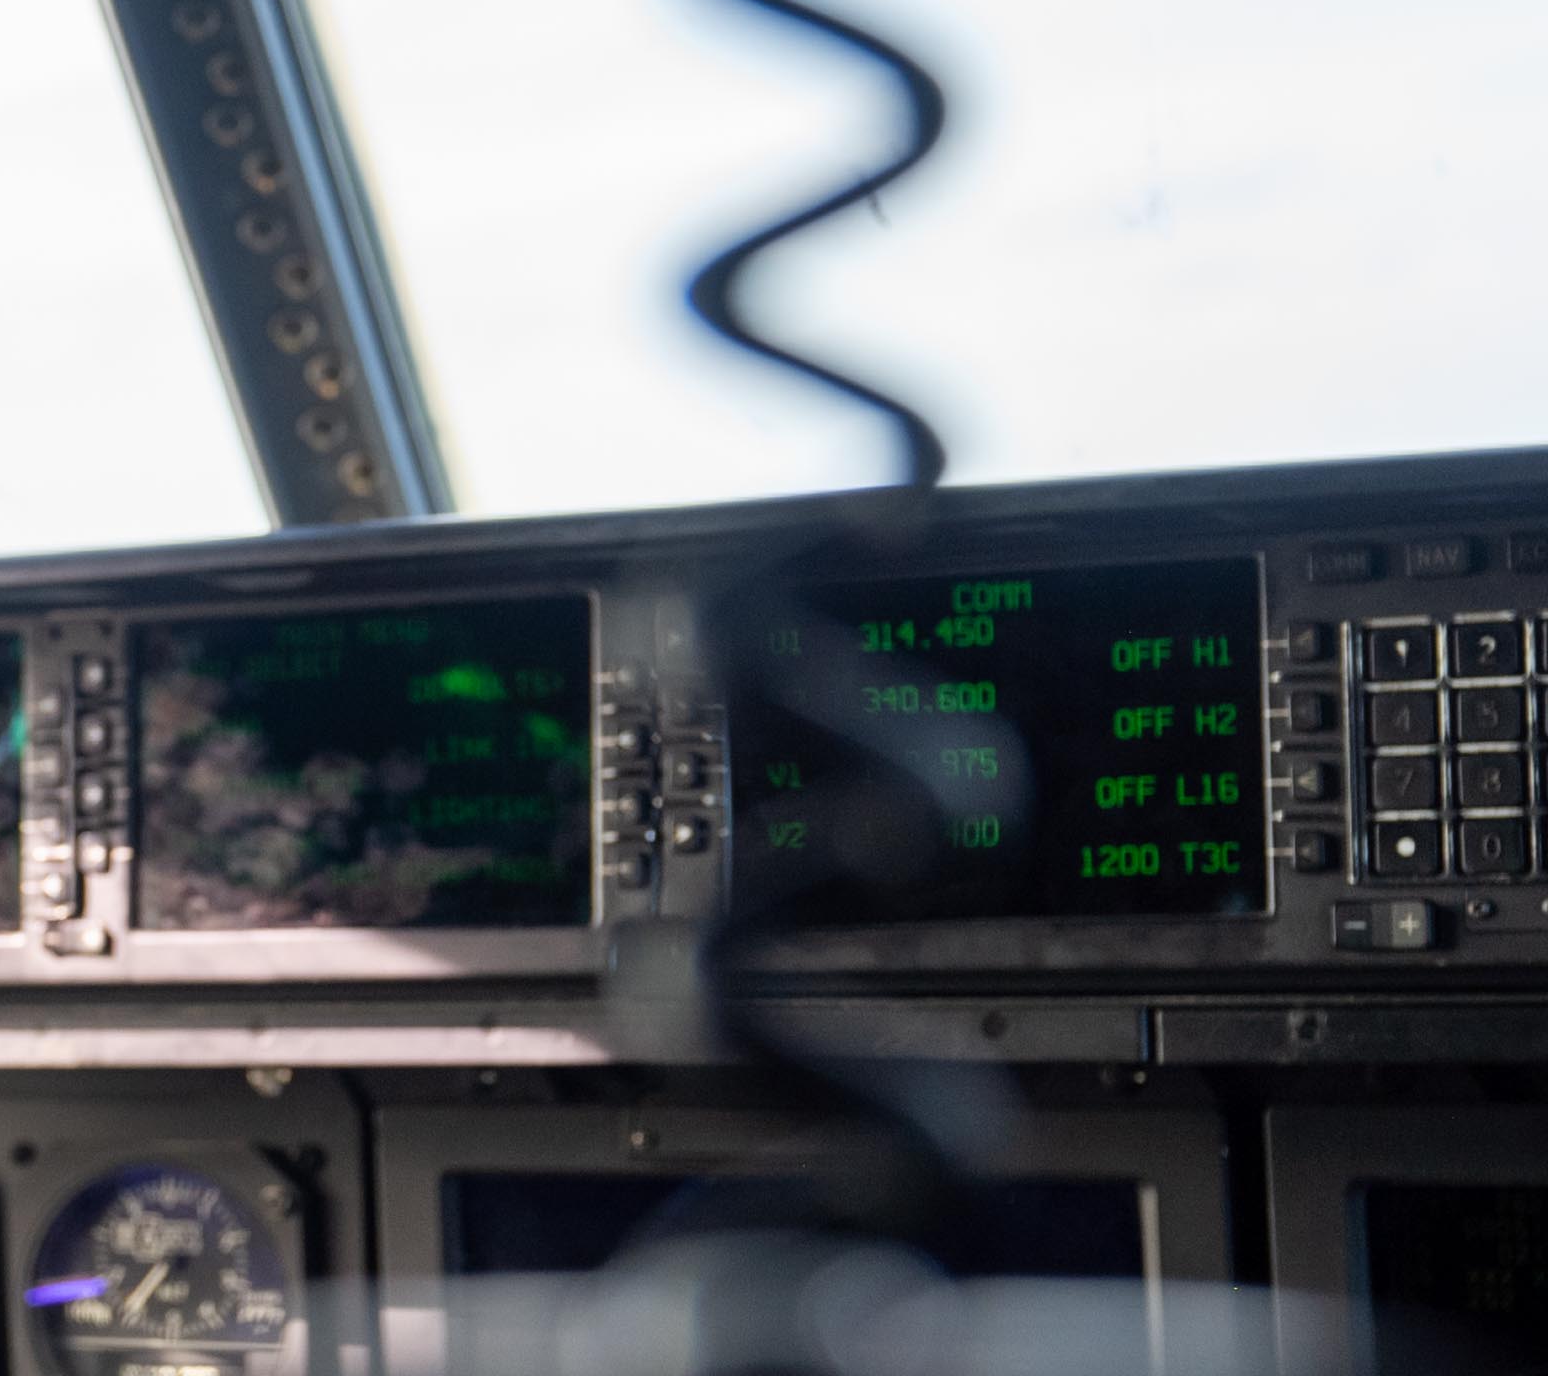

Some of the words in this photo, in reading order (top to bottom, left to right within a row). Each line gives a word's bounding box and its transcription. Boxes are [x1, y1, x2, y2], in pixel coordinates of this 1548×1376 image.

[1417, 543, 1459, 570] NAV
[952, 581, 1033, 613] COMM
[1112, 636, 1173, 673] OFF
[1192, 635, 1233, 670] H1
[1113, 704, 1175, 742] OFF
[1195, 703, 1238, 737] H2
[1095, 774, 1157, 810] OFF
[1176, 773, 1240, 807] L16
[1080, 843, 1160, 878] 1200
[1181, 842, 1242, 876] T3C
